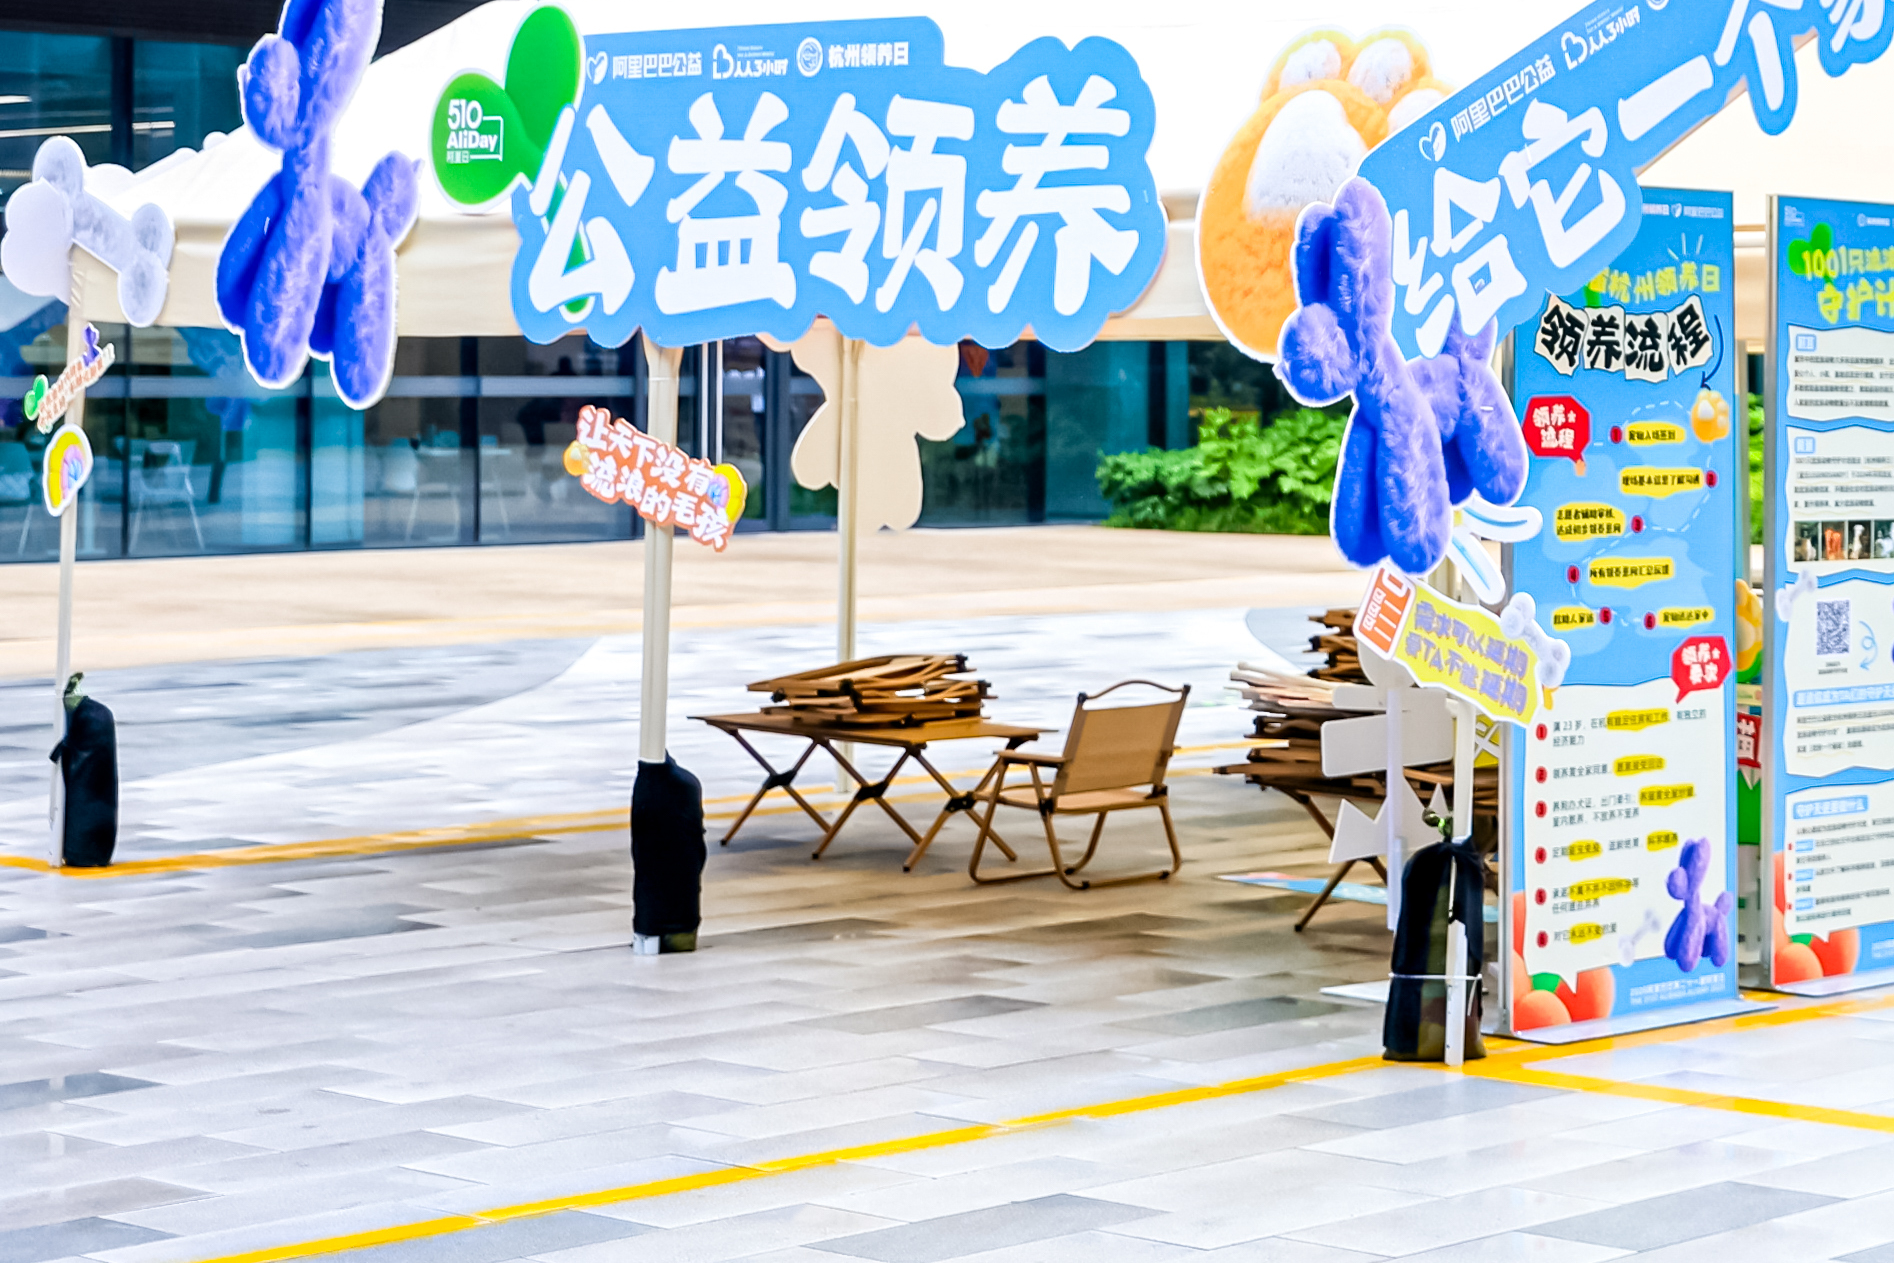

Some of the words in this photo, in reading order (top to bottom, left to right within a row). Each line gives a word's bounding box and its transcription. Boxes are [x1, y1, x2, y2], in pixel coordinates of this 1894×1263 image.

[612, 51, 702, 80] 阿里巴巴公益
[829, 42, 909, 68] 杭州领养日
[1451, 54, 1556, 143] 阿里巴巴公益
[447, 99, 483, 131] 510
[446, 131, 498, 152] AliDay
[447, 151, 470, 164] 阿里日
[529, 75, 1140, 317] 公益领养
[1540, 303, 1710, 373] 领养流程
[1533, 404, 1566, 428] 领养
[577, 409, 714, 496] 让天下没有
[583, 452, 729, 549] 流浪的毛孩
